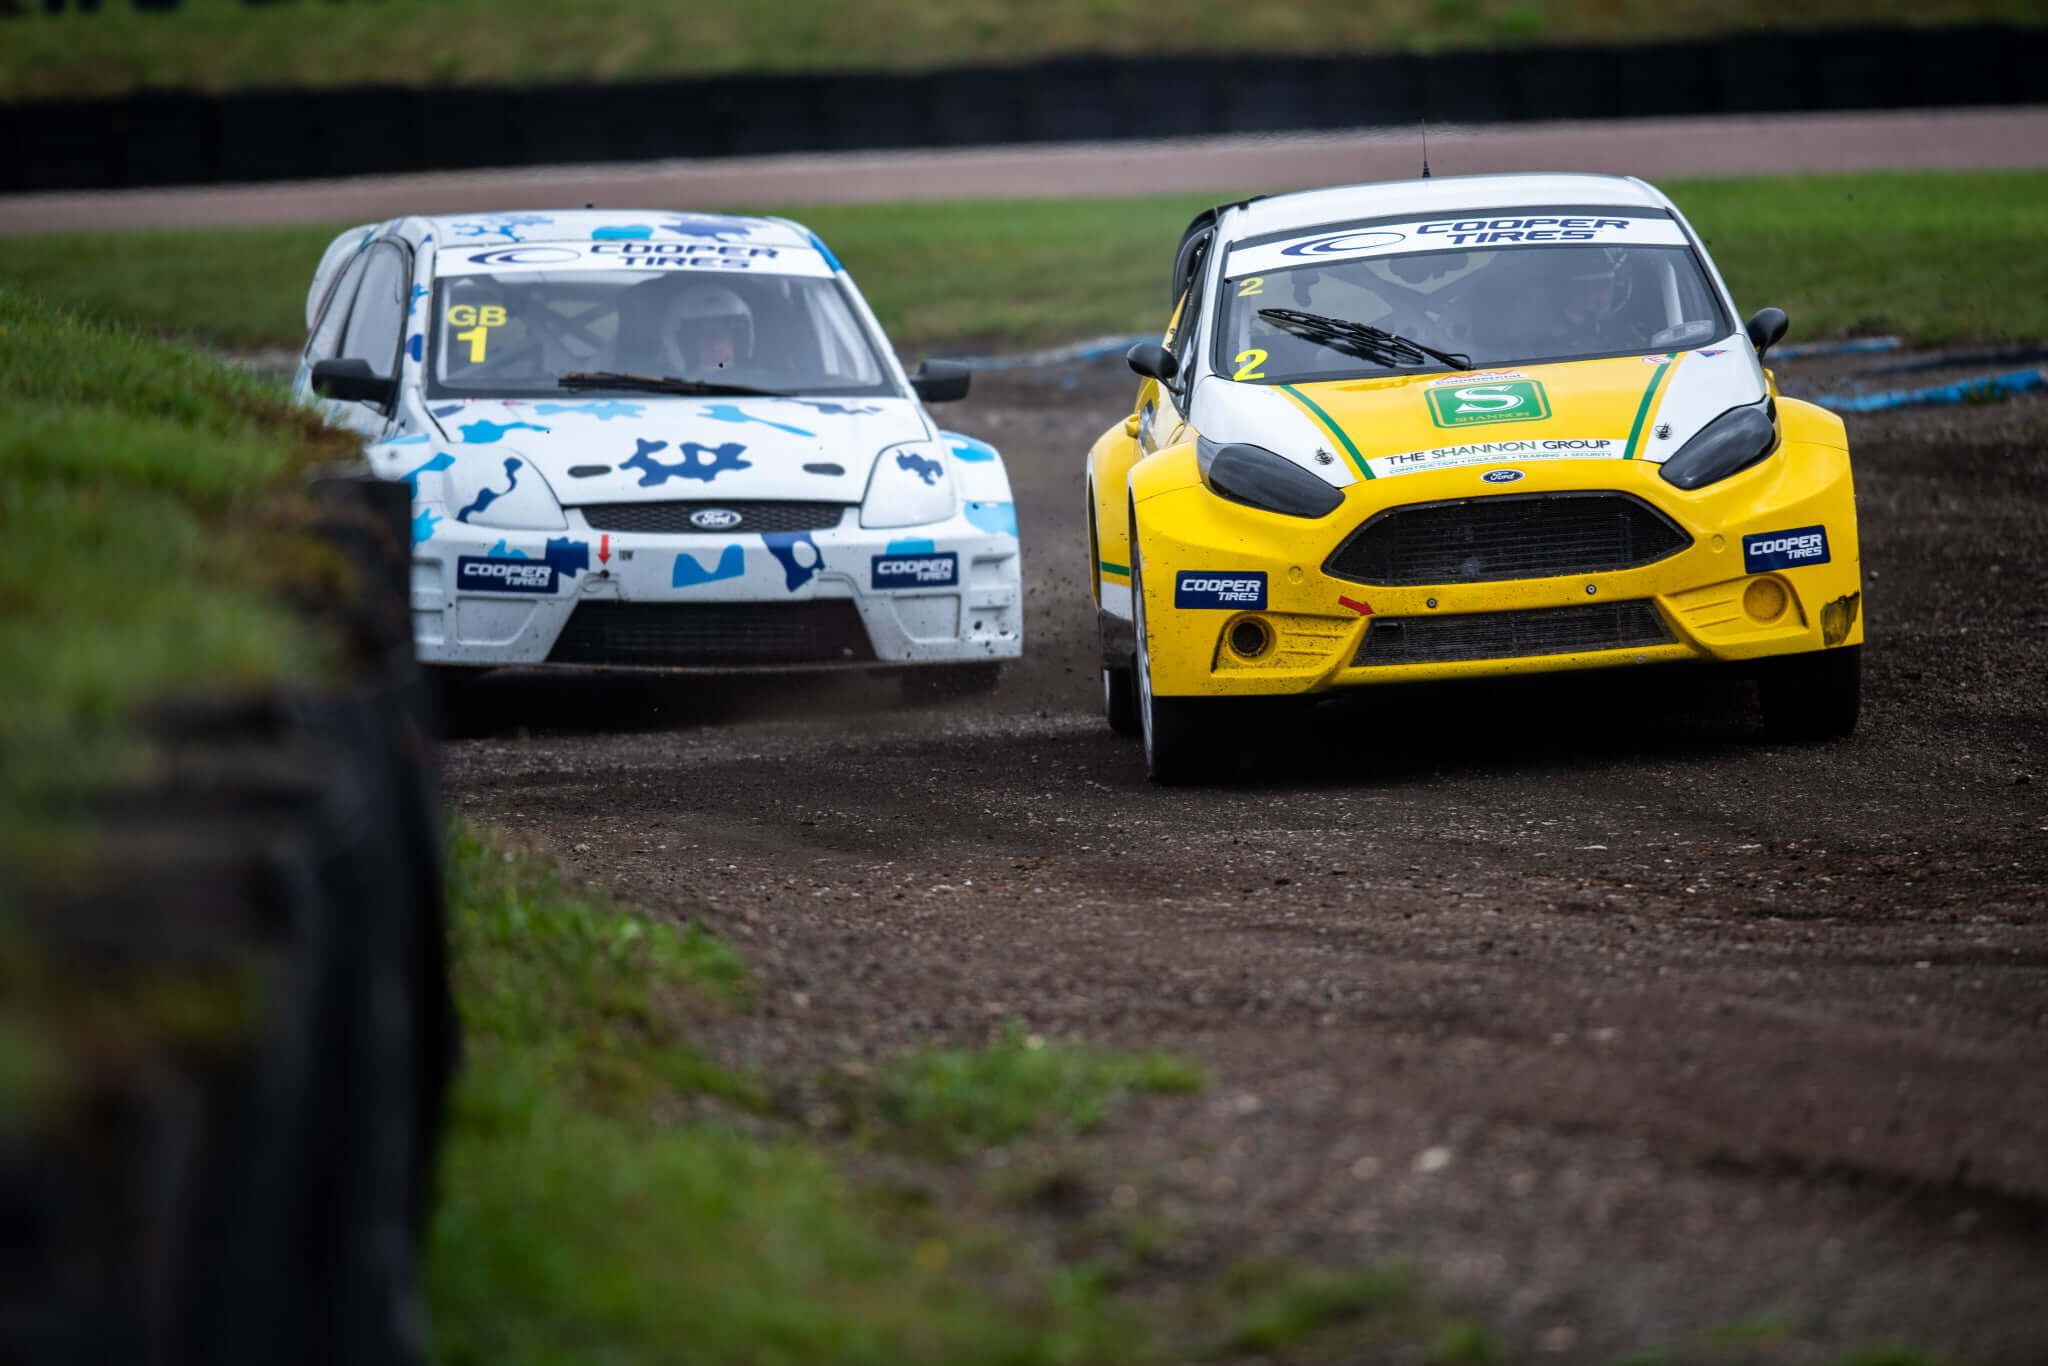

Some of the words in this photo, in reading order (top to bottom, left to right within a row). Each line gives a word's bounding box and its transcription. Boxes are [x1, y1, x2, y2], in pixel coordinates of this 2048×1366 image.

[1416, 218, 1630, 235] COOPER
[1447, 230, 1603, 245] TIRES
[591, 243, 779, 259] COOPER
[619, 255, 751, 268] TIRES
[1238, 277, 1265, 296] 2
[448, 305, 507, 327] GB
[457, 327, 487, 363] 1
[1233, 348, 1268, 381] 2
[1454, 385, 1525, 414] S
[1384, 451, 1426, 466] THE
[1431, 441, 1537, 459] SHANNON
[1542, 439, 1611, 451] GROUP
[1489, 470, 1517, 481] Ford
[702, 511, 731, 525] Ford
[1749, 533, 1823, 556] COOPER
[1786, 546, 1823, 559] TIRES
[463, 562, 552, 578] COOPER
[878, 558, 954, 575] COOPER
[505, 576, 550, 587] TIRES
[1181, 579, 1261, 592] COOPER
[1218, 592, 1260, 601] TIRES
